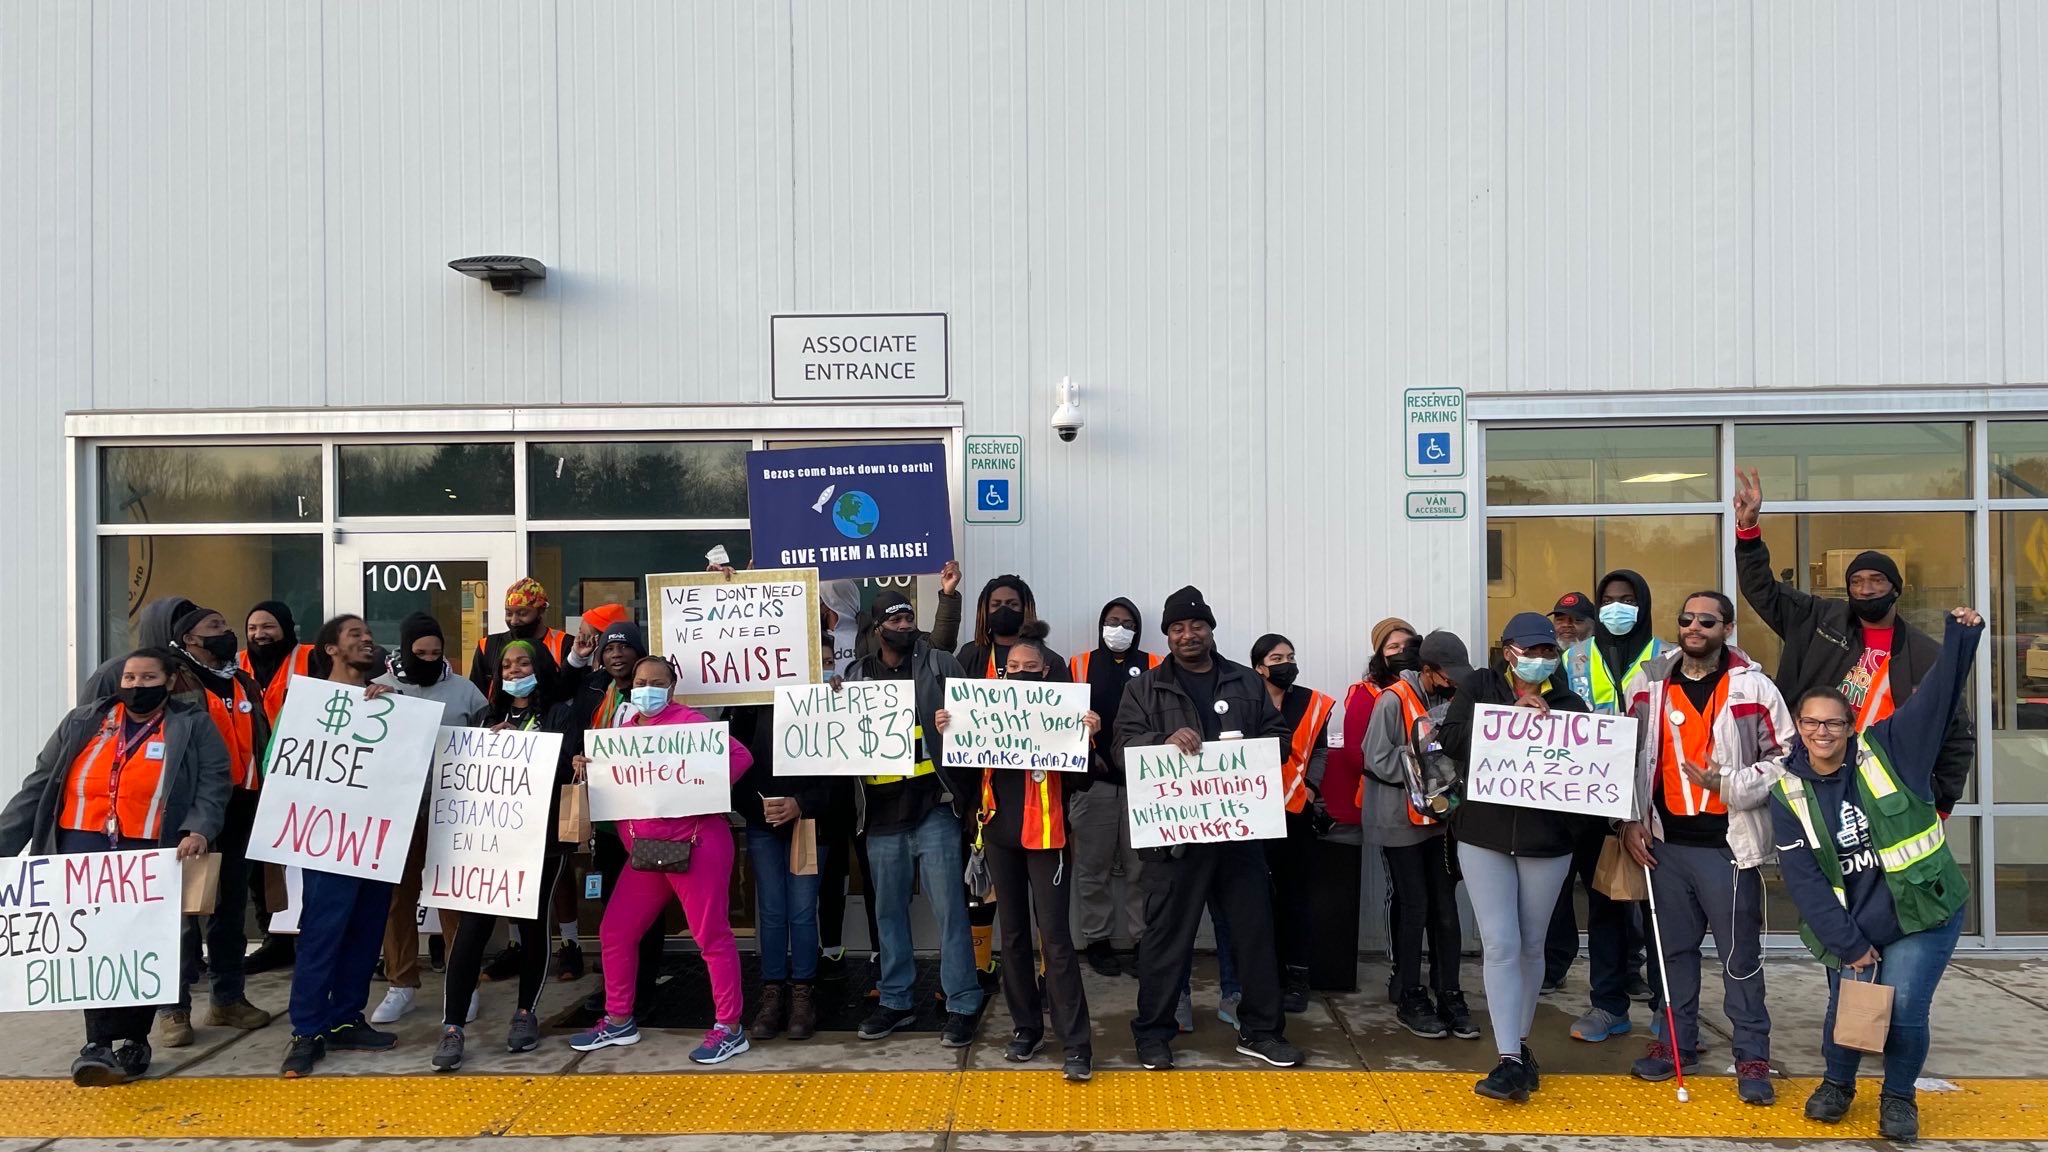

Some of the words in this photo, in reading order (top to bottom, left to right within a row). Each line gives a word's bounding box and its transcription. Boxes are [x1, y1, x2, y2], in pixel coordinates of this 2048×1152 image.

[802, 335, 917, 354] ASSOCIATE
[804, 362, 916, 381] ENTRANCE
[1408, 396, 1460, 408] RESERVED
[1411, 411, 1457, 423] PARKING
[968, 442, 1019, 455] RESERVED
[763, 468, 795, 480] Bezos
[798, 466, 827, 478] come
[829, 464, 855, 476] back
[858, 463, 886, 475] down
[888, 463, 899, 473] to
[901, 462, 933, 473] earth!
[971, 458, 1016, 470] PARKING
[1426, 497, 1446, 506] VAN
[780, 548, 816, 565] GIVE
[820, 546, 861, 563] THEM
[865, 545, 876, 560] A
[880, 542, 928, 559] RAISE!
[366, 564, 447, 592] 100A
[667, 588, 700, 605] WE
[716, 585, 758, 602] DON'T
[763, 585, 803, 599] NEED
[682, 599, 784, 622] SNACKS
[676, 627, 703, 644] WE
[719, 625, 781, 639] NEED
[701, 646, 797, 684] RAISE
[787, 683, 898, 717] WHERE'S
[317, 689, 396, 744] $3
[970, 708, 1031, 734] fight
[1483, 710, 1615, 748] JUSTICE
[443, 730, 538, 764] AMAZON
[785, 721, 849, 760] OUR
[858, 708, 915, 760] $3?
[271, 738, 374, 789] RAISE
[1139, 745, 1248, 781] AMAZON
[1526, 746, 1576, 763] FOR
[440, 763, 532, 796] ESCUCHA
[1477, 758, 1610, 778] AMAZON
[1153, 780, 1183, 799] IS
[1475, 777, 1620, 804] WORKERS
[434, 799, 524, 829] ESTAMOS
[273, 802, 391, 870] NOW!
[453, 833, 473, 851] EN
[481, 834, 499, 853] LA
[0, 858, 50, 907] WE
[65, 852, 164, 904] MAKE
[432, 864, 525, 908] LUCHA!
[27, 950, 161, 1006] BILLIONS
